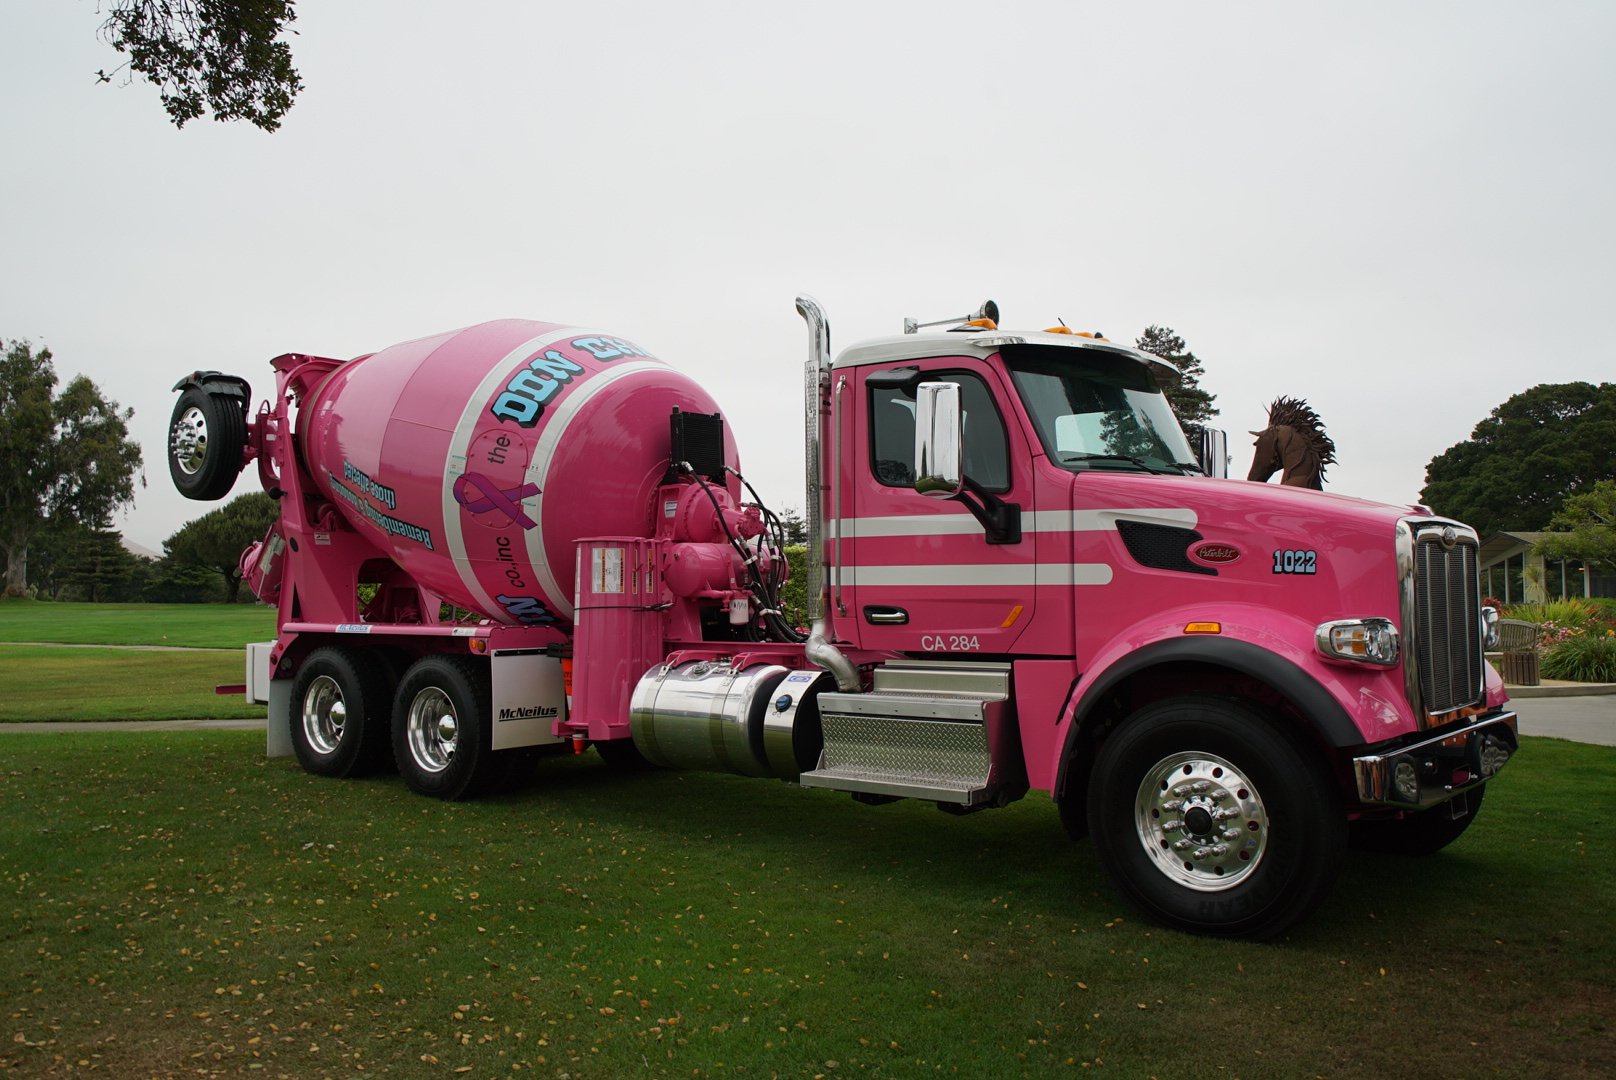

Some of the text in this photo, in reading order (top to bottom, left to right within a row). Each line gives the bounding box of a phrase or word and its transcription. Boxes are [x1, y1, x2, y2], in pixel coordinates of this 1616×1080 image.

[490, 350, 585, 428] DON
[487, 436, 511, 464] the
[370, 480, 396, 510] those
[1200, 547, 1236, 558] Peterbilt
[1273, 550, 1317, 575] 1022
[921, 635, 980, 651] CA 284
[499, 706, 558, 719] McNeilus
